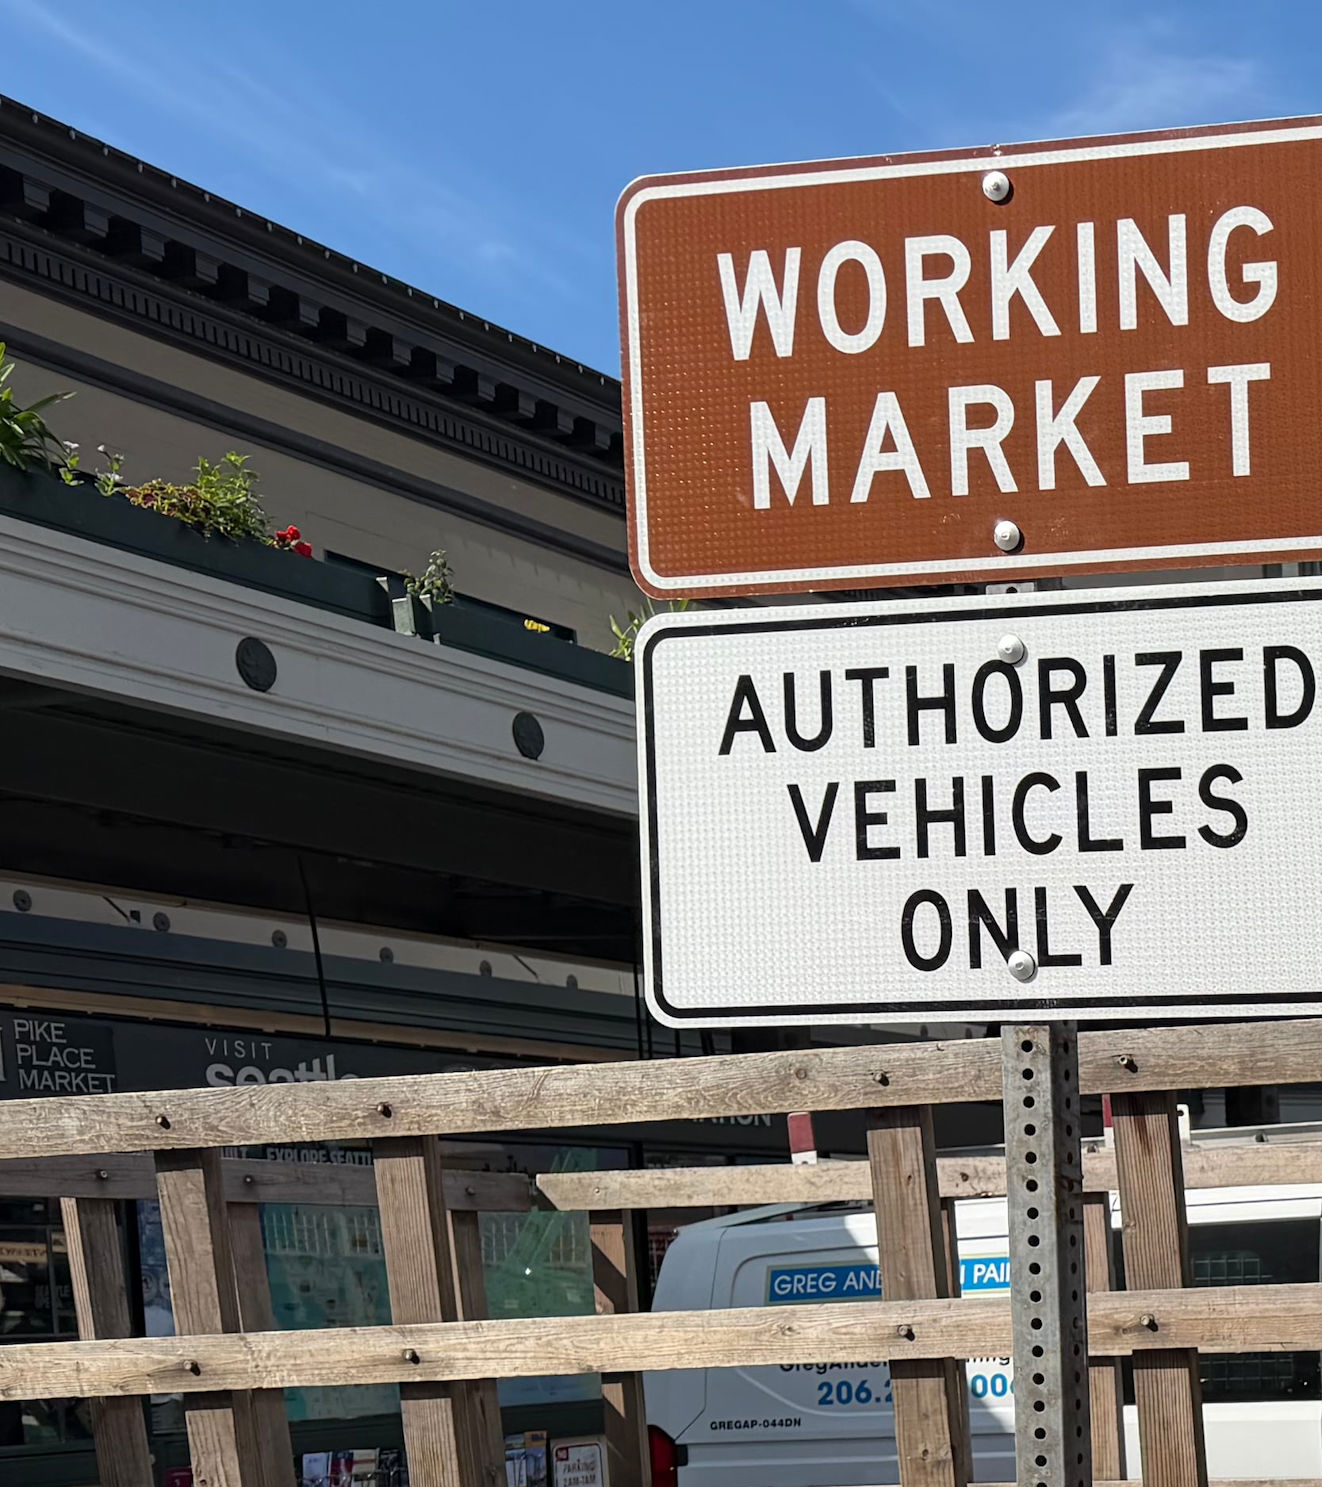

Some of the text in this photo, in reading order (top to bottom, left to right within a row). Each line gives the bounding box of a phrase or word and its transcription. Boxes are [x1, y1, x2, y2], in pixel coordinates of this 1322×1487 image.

[717, 205, 1279, 361] WORKING
[750, 362, 1271, 510] MARKET
[718, 645, 1316, 756] AUTHORIZED
[787, 763, 1249, 863] VEHICLES
[901, 882, 1134, 972] ONLY
[13, 1018, 67, 1044] PIKE
[16, 1043, 97, 1069] PLACE
[204, 1037, 273, 1061] VISIT
[18, 1068, 116, 1094] MARKET
[773, 1271, 837, 1296] GREG
[710, 1417, 802, 1431] GREGAP-044DN
